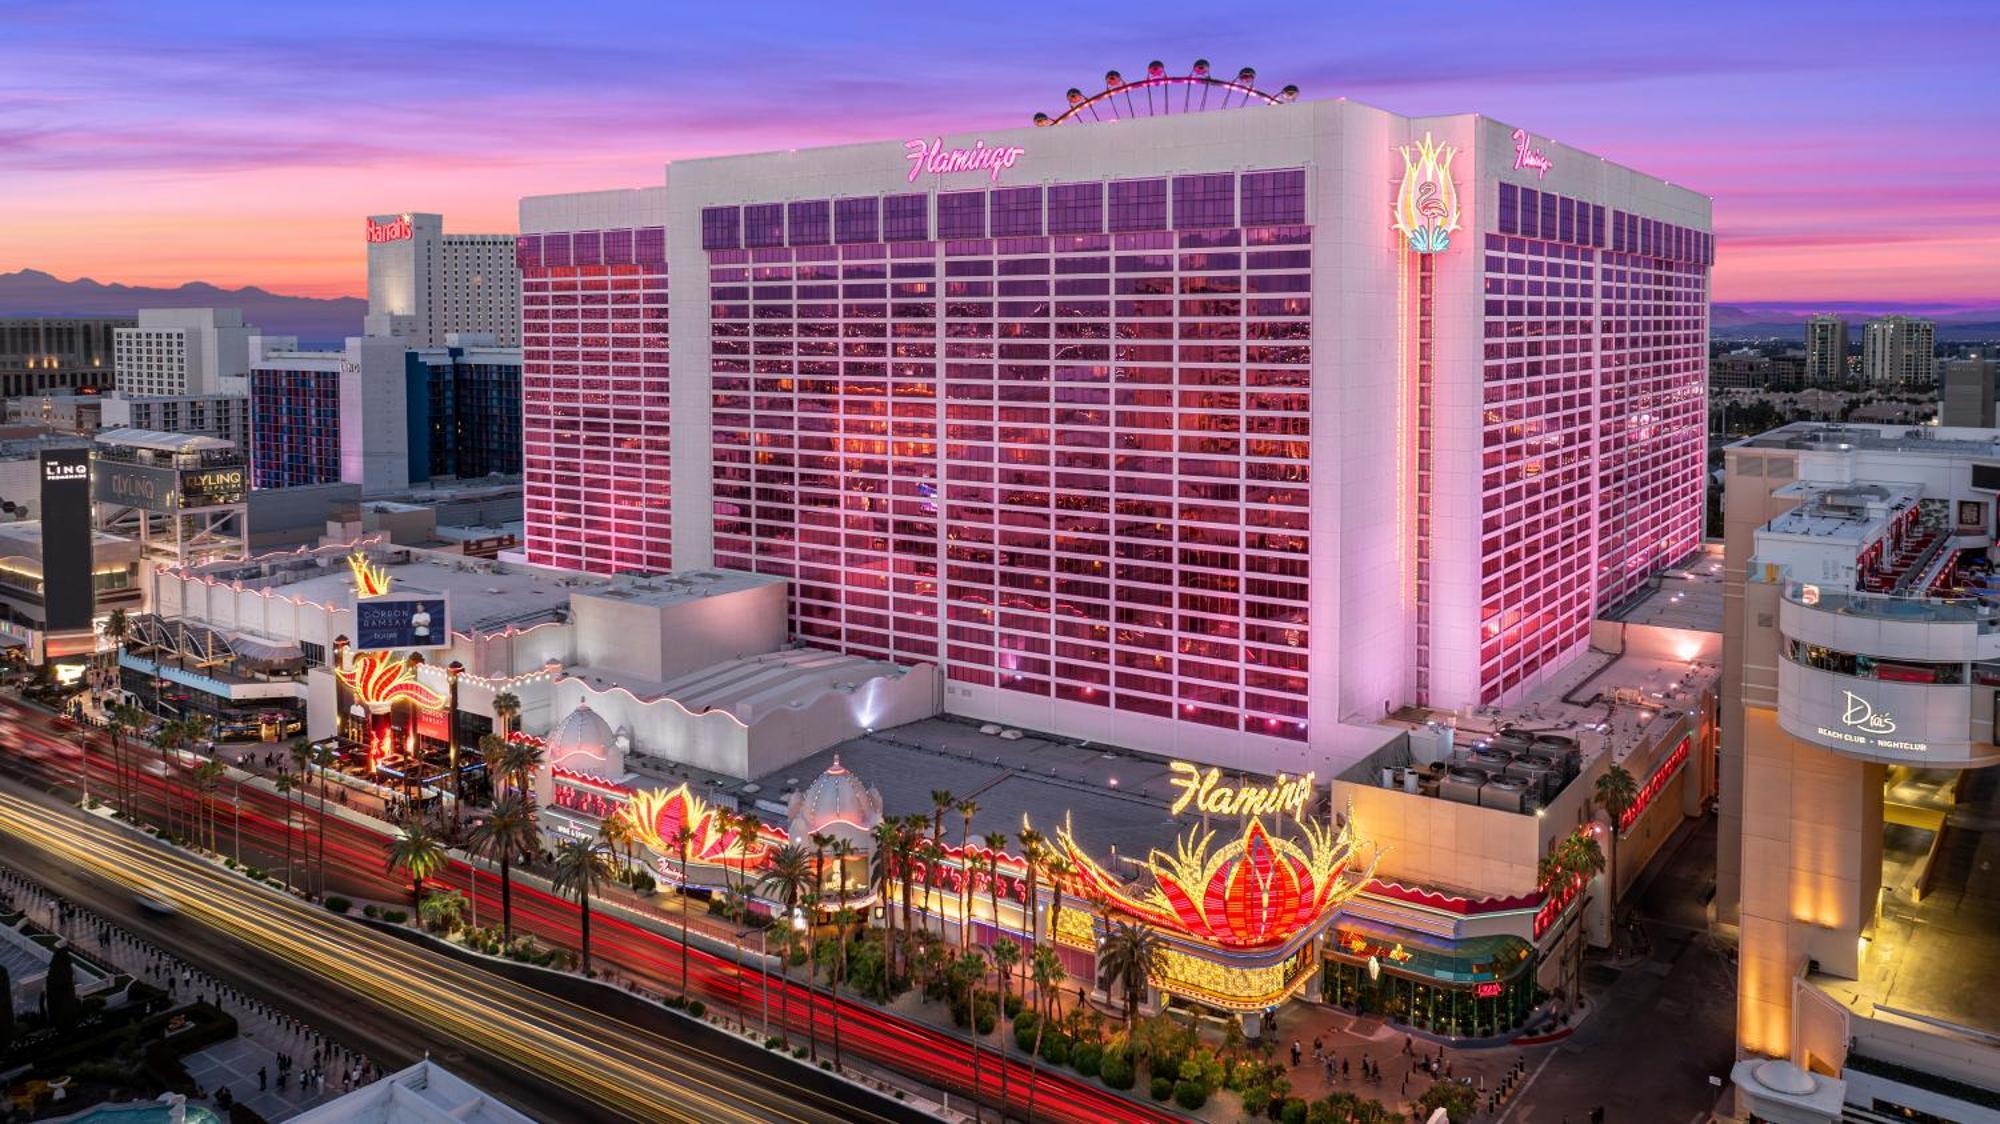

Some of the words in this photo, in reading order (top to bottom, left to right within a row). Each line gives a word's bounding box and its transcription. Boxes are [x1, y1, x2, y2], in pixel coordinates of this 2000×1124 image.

[905, 137, 1024, 181] Flamingo
[46, 465, 87, 475] LINQ
[363, 609, 409, 619] GORDON
[363, 619, 407, 628] RAMSAY
[1818, 727, 1842, 740] BEACH
[1844, 733, 1866, 744] CLUB
[1878, 739, 1927, 752] NIGHTCLUB
[1170, 760, 1316, 822] Flamingo
